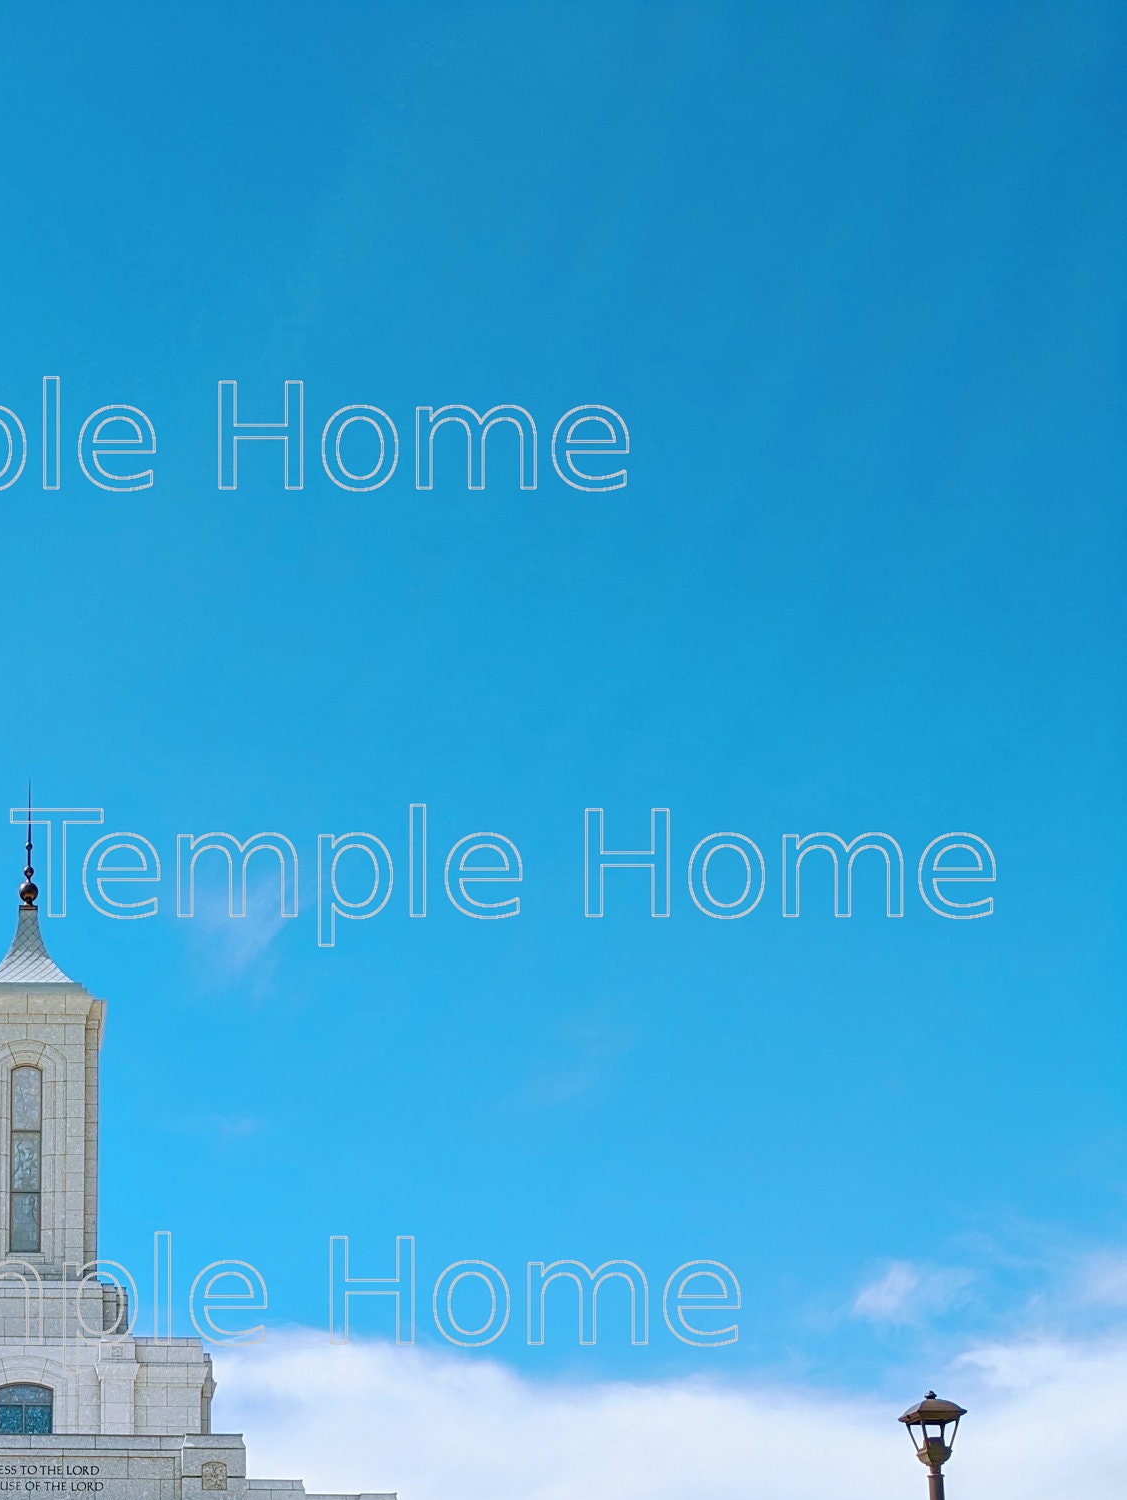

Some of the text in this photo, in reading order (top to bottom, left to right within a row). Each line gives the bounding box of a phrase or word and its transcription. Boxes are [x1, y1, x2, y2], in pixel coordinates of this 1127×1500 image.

[20, 1465, 38, 1475] TO
[39, 1465, 63, 1476] THE
[66, 1465, 100, 1476] LORD
[25, 1481, 41, 1491] OF
[44, 1481, 67, 1491] THE
[71, 1481, 104, 1492] LORD
